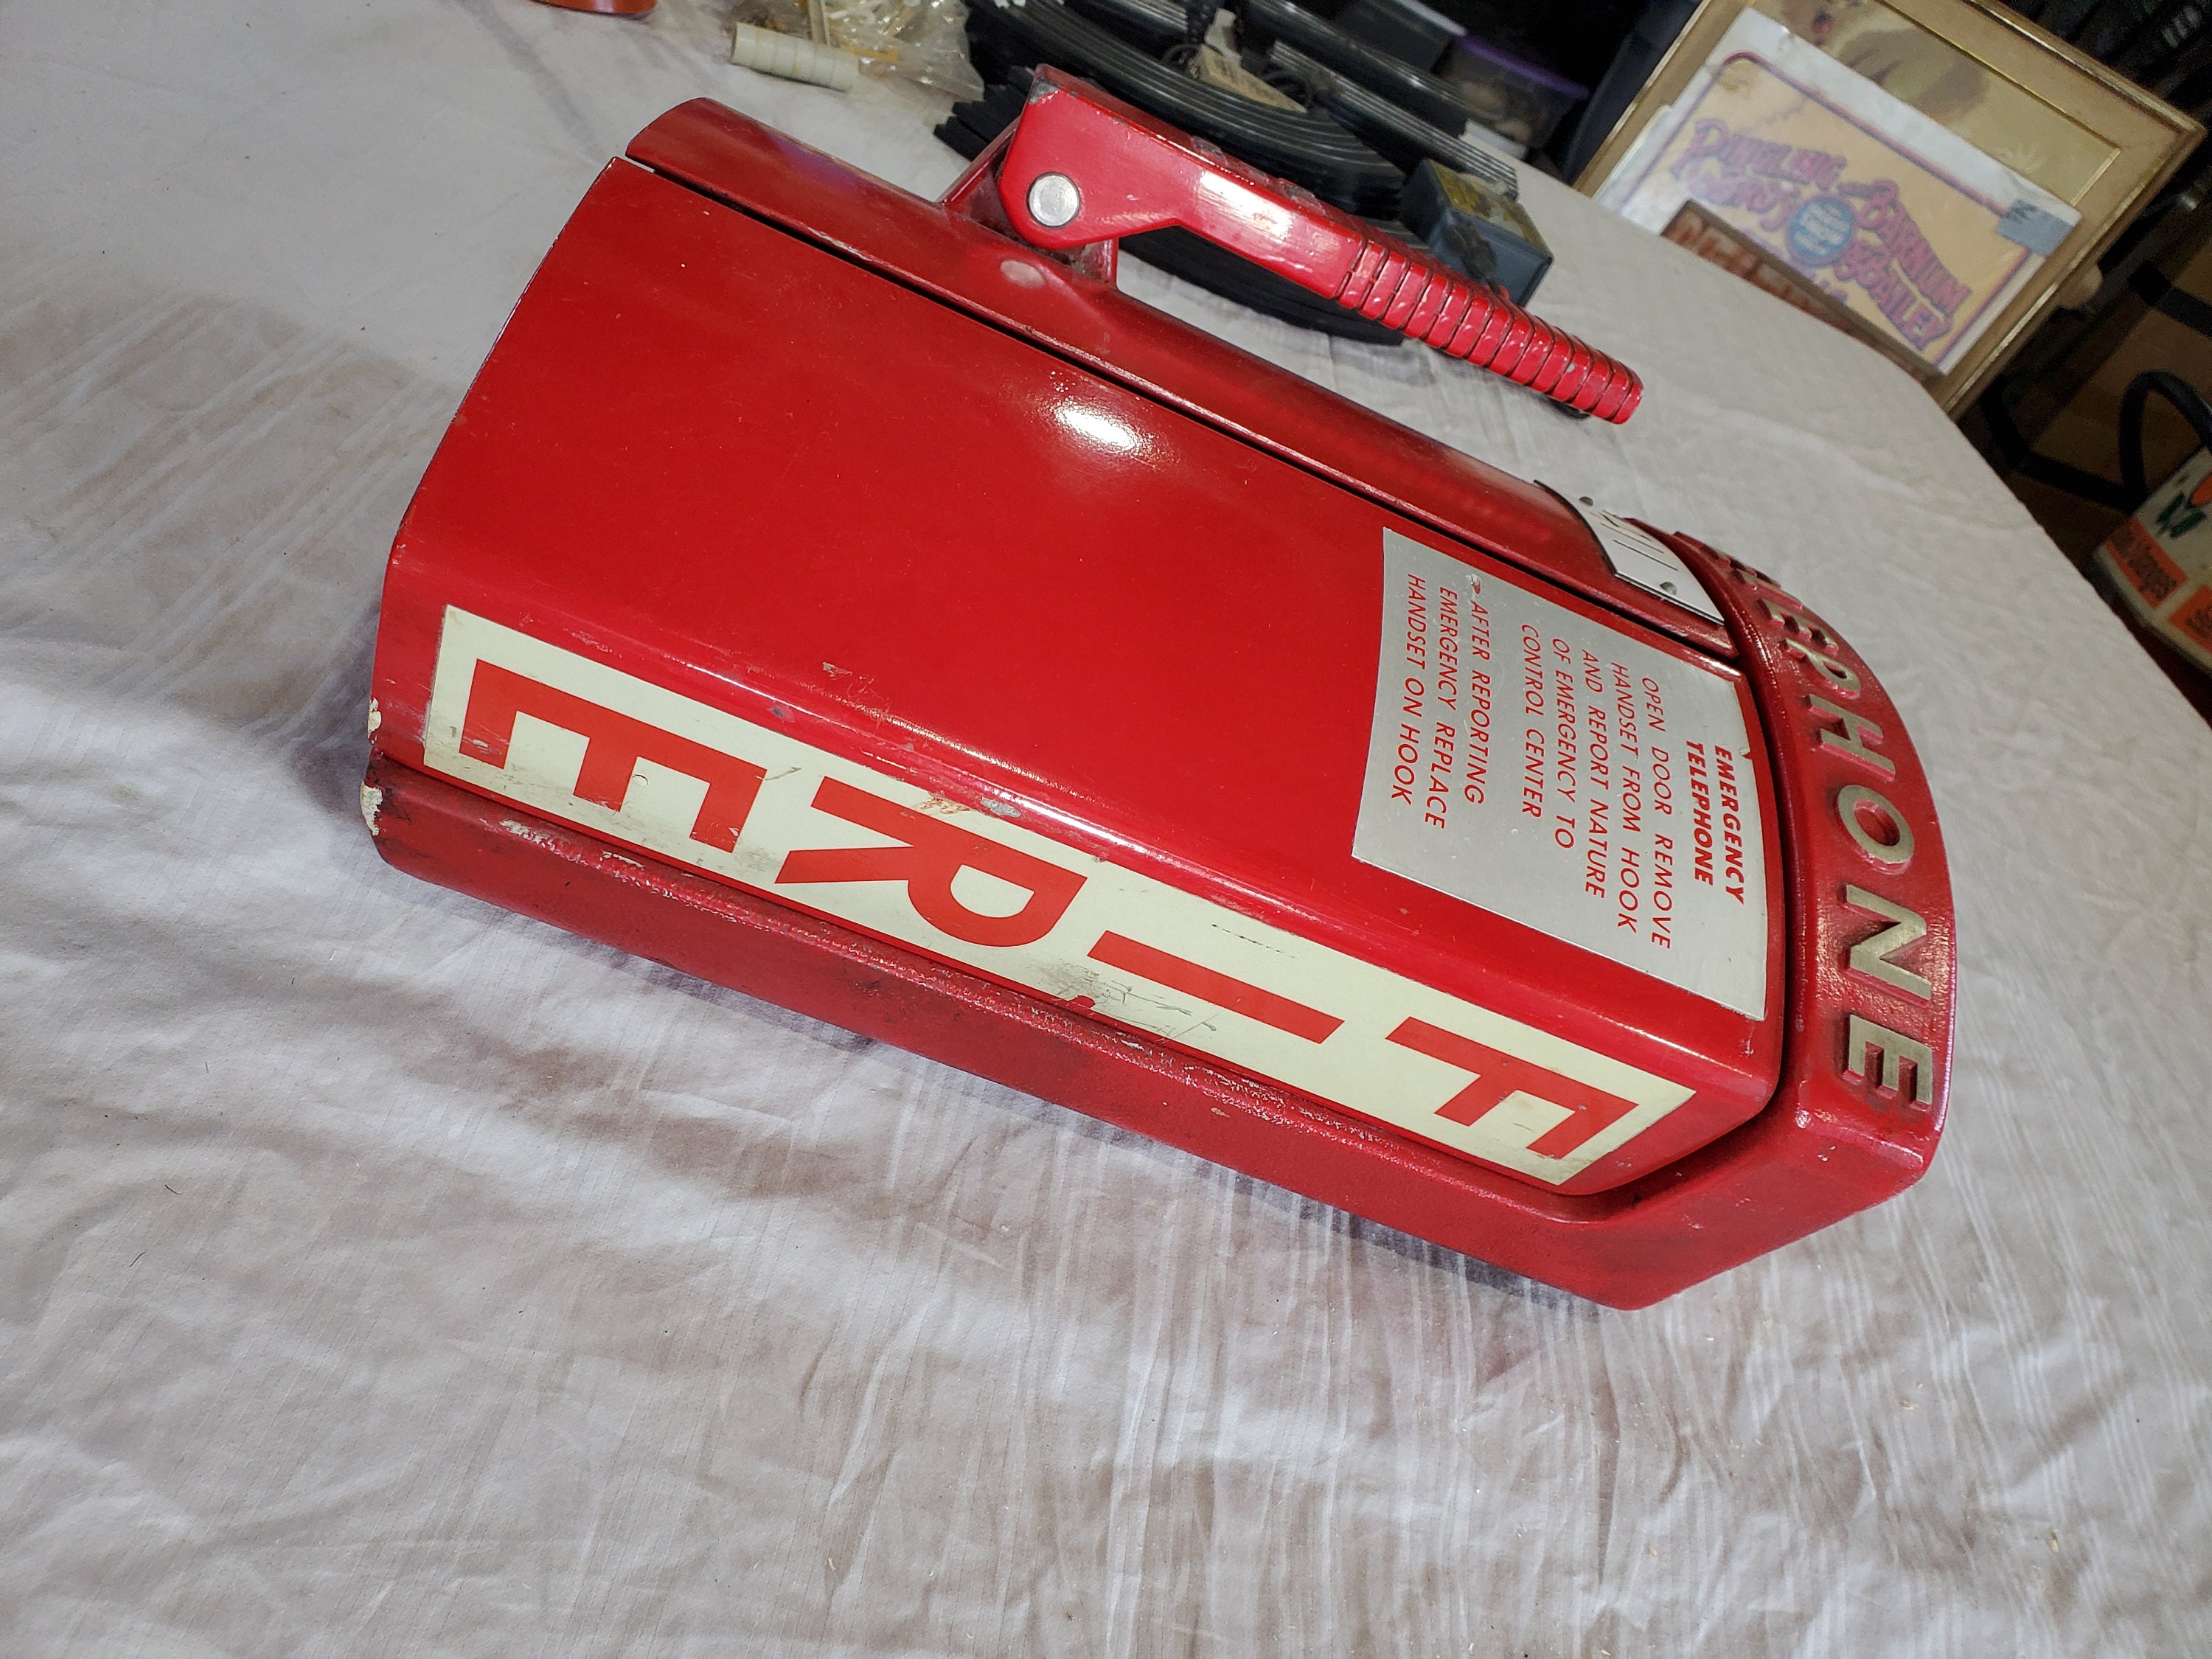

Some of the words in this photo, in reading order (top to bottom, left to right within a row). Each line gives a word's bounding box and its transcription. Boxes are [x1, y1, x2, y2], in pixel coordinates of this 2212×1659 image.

[1855, 179, 1972, 317] BARNUM
[1855, 246, 1952, 351] BAILEY
[1405, 573, 1427, 670] HANDSET
[1433, 586, 1459, 711] EMERGENCY
[1470, 600, 1492, 661] AFTER
[1551, 638, 1572, 664] OF
[1402, 676, 1425, 718] ON
[1520, 624, 1544, 717] CONTROL
[1582, 650, 1604, 694] AND
[1611, 661, 1640, 757] HANDSET
[1641, 677, 1667, 732] OPEN
[1391, 723, 1422, 806] HOOK
[1424, 721, 1457, 830] REPLACE
[1464, 669, 1492, 805] REPORTING
[1521, 728, 1546, 818] CENTER
[1554, 669, 1577, 803] EMERGENCY
[1587, 705, 1610, 790] REPORT
[1651, 745, 1673, 815] DOOR
[1554, 815, 1576, 849] TO
[1621, 765, 1642, 832] FROM
[1686, 740, 1714, 886] TELEPHONE
[1714, 745, 1745, 905] EMERGENCY
[1584, 798, 1610, 899] NATURE
[1616, 846, 1641, 933] HOOK
[1651, 833, 1674, 950] REMOVE
[459, 658, 1639, 1160] FIRE
